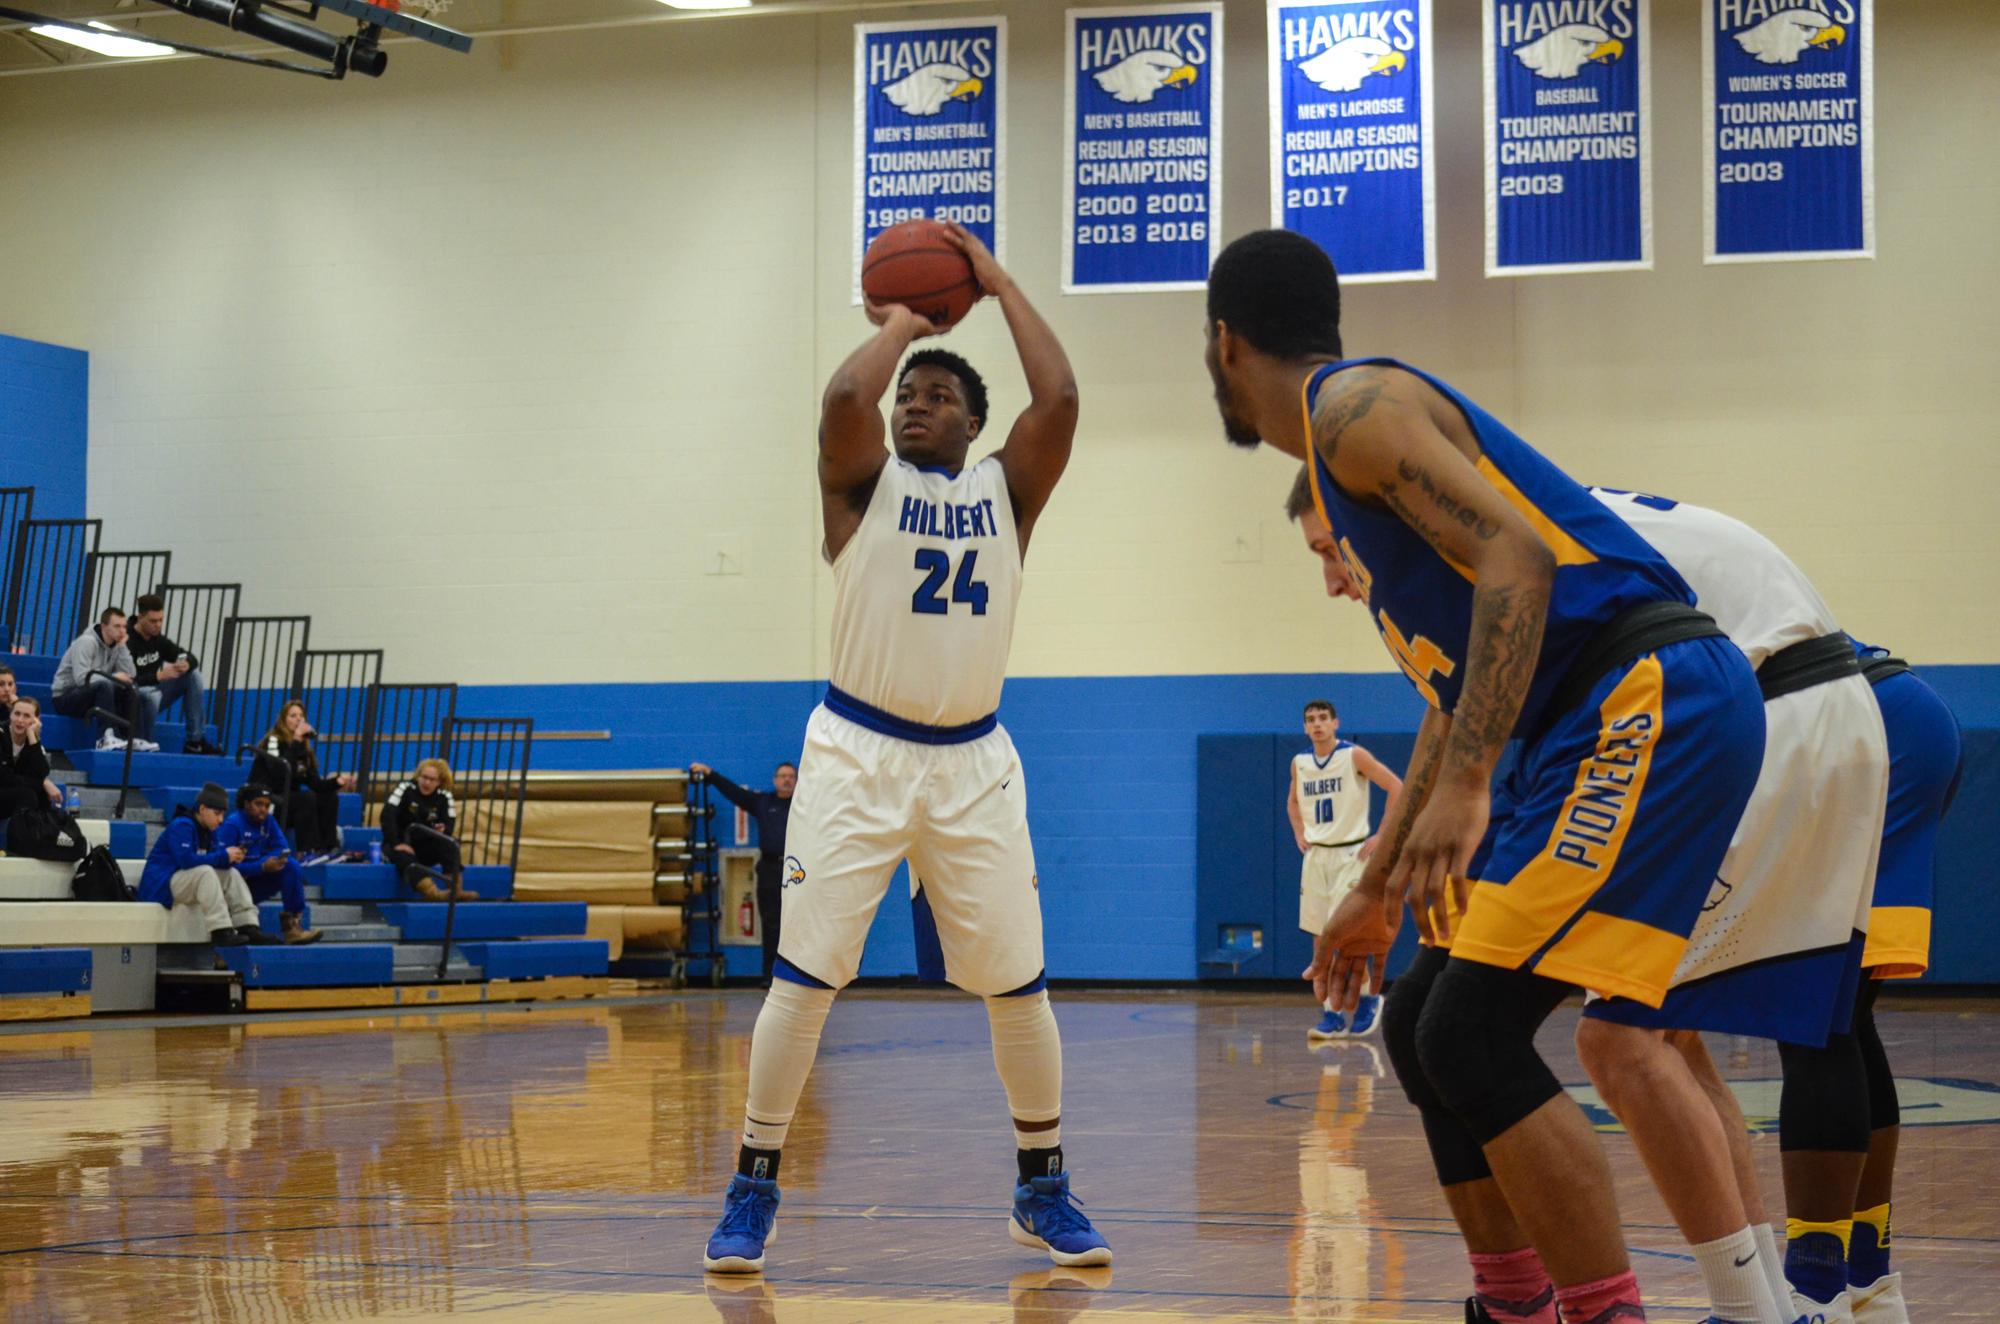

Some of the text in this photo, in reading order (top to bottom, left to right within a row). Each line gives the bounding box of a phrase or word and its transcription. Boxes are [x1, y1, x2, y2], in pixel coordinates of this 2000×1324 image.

[1284, 8, 1415, 61] HAWKS
[1500, 0, 1633, 47] HAWKS
[1080, 23, 1206, 71] HAWKS
[870, 38, 992, 85] HAWKS
[1729, 72, 1847, 92] WOMEN'S SOCCER
[1297, 97, 1405, 120] MEN'S LACROSSE
[1536, 87, 1599, 106] BASEBALL
[1084, 110, 1202, 129] MEN'S BASKETBALL
[1719, 98, 1857, 125] TOURNAMENT
[874, 122, 987, 143] MEN'S BASKETBALL
[1286, 123, 1419, 152] REGULAR SEASON
[1499, 111, 1636, 139] TOURNAMENT
[1720, 122, 1858, 151] CHAMPIONS
[868, 148, 993, 173] TOURNAMENT
[1078, 137, 1207, 160] REGULAR SEASON
[1286, 146, 1419, 177] CHAMPIONS
[1501, 135, 1637, 165] CHAMPIONS
[868, 170, 993, 197] CHAMPIONS
[1079, 159, 1207, 185] CHAMPIONS
[1501, 173, 1564, 196] 2003
[1720, 161, 1783, 183] 2003
[1078, 193, 1206, 216] 2000 2001
[1287, 186, 1348, 209] 2017
[934, 205, 992, 224] 2000
[1077, 221, 1206, 244] 2013 2016
[899, 495, 997, 540] HILBERT
[912, 548, 989, 616] 24
[1303, 777, 1343, 797] HILBERT
[1553, 713, 1654, 870] PIONEERS
[1315, 798, 1334, 824] 10
